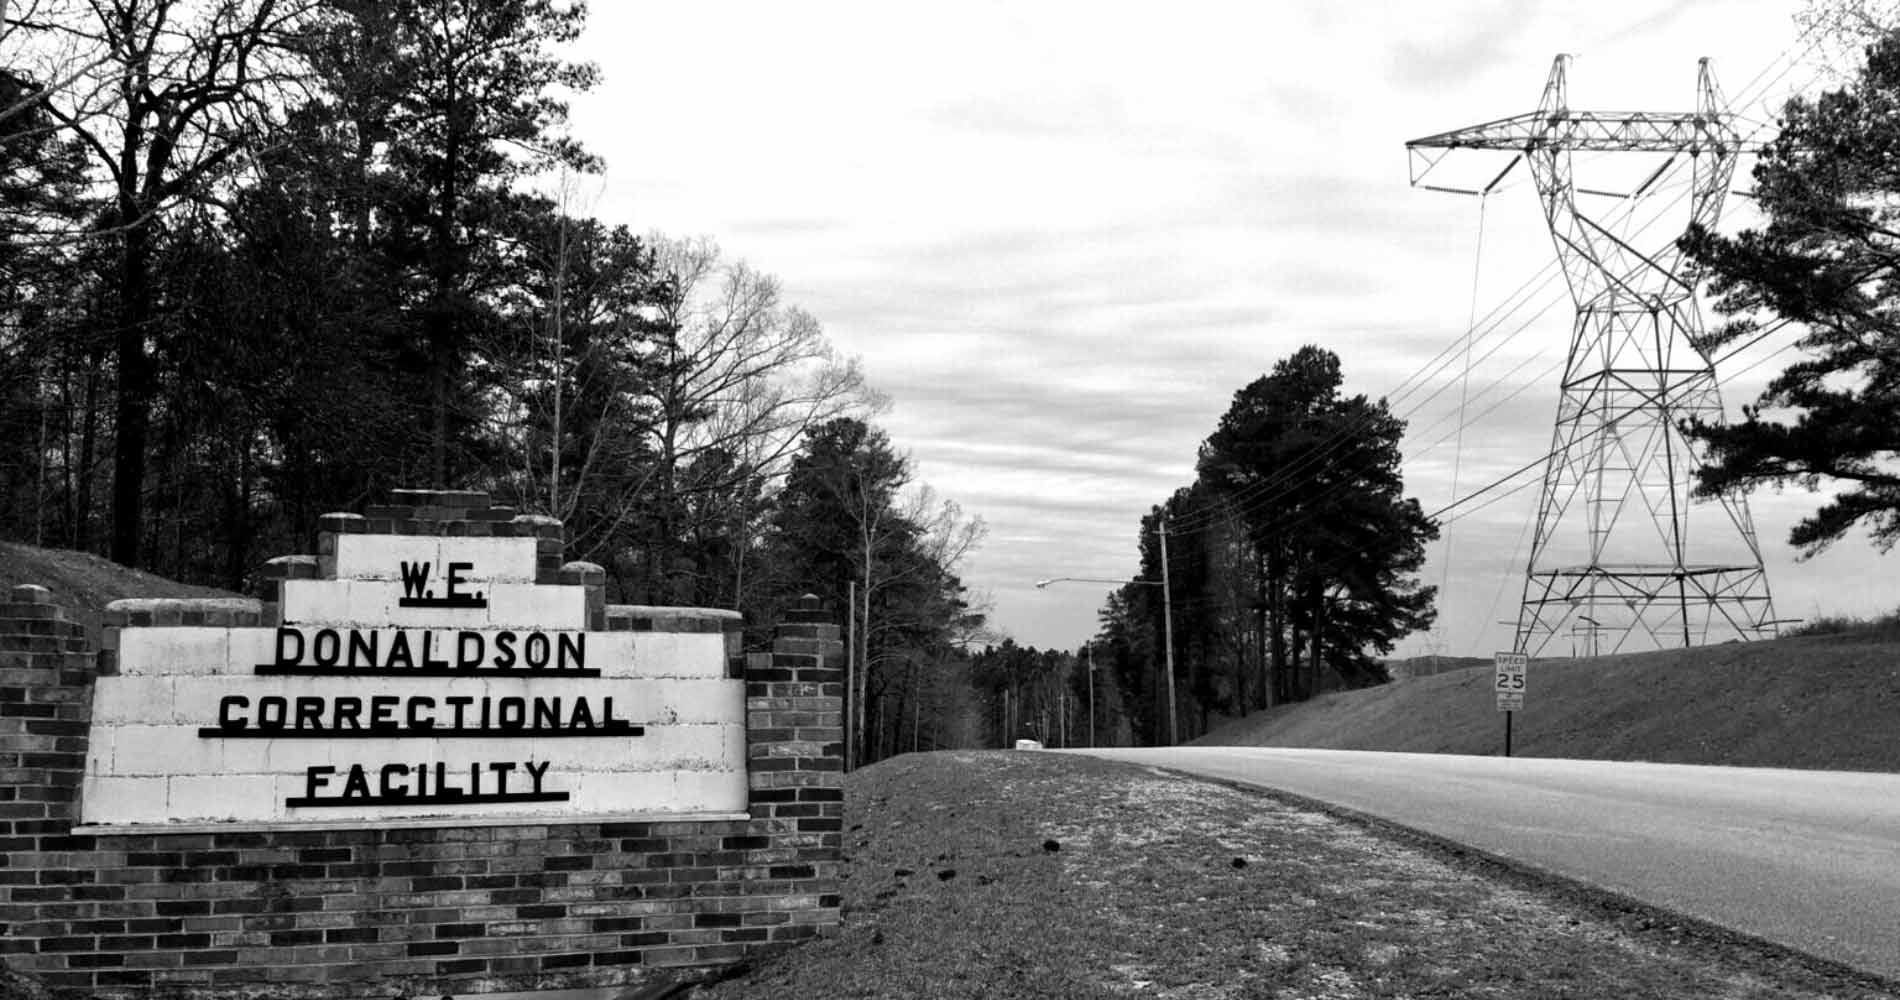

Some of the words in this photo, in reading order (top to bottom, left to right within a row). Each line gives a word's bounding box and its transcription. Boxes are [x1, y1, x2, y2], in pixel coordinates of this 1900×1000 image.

[400, 561, 484, 599] W.E.
[277, 627, 585, 668] DONALDSON
[1497, 673, 1524, 689] 25
[219, 696, 629, 729] CORRECTIONAL
[306, 761, 549, 797] FACILITY
